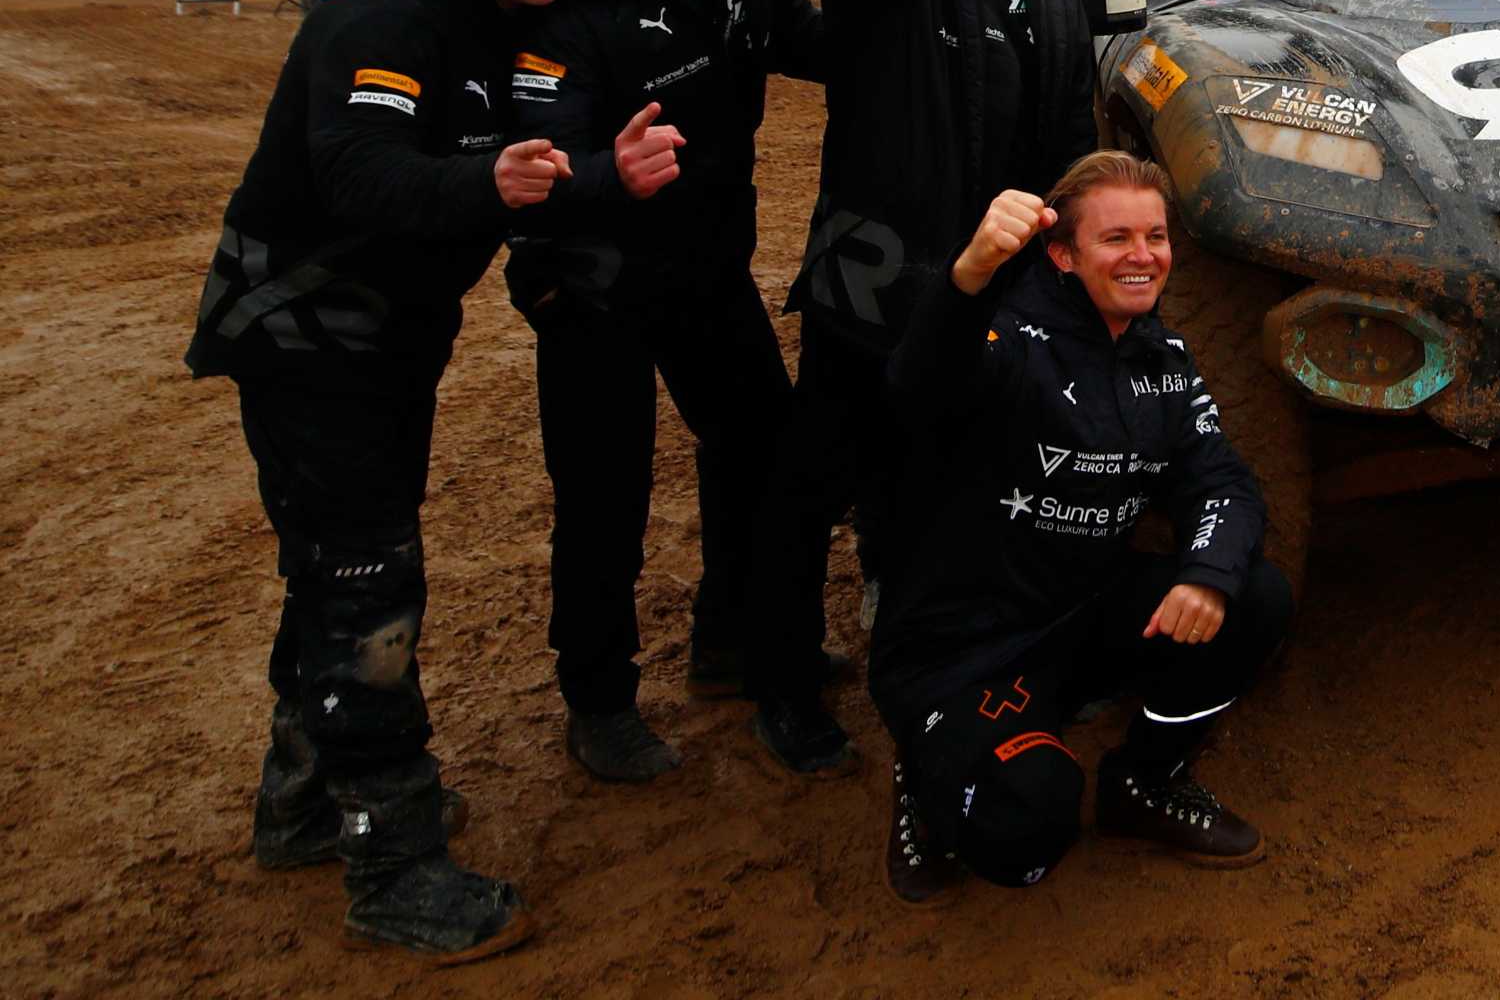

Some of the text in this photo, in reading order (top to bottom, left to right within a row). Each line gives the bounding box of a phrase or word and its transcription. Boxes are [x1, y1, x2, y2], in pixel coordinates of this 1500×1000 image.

[1280, 85, 1377, 114] VULCAN
[1216, 104, 1248, 117] ZERO
[1250, 110, 1303, 127] CARBON
[1272, 98, 1372, 127] ENERGY
[1073, 460, 1104, 474] ZERO
[1035, 520, 1054, 531] ECO
